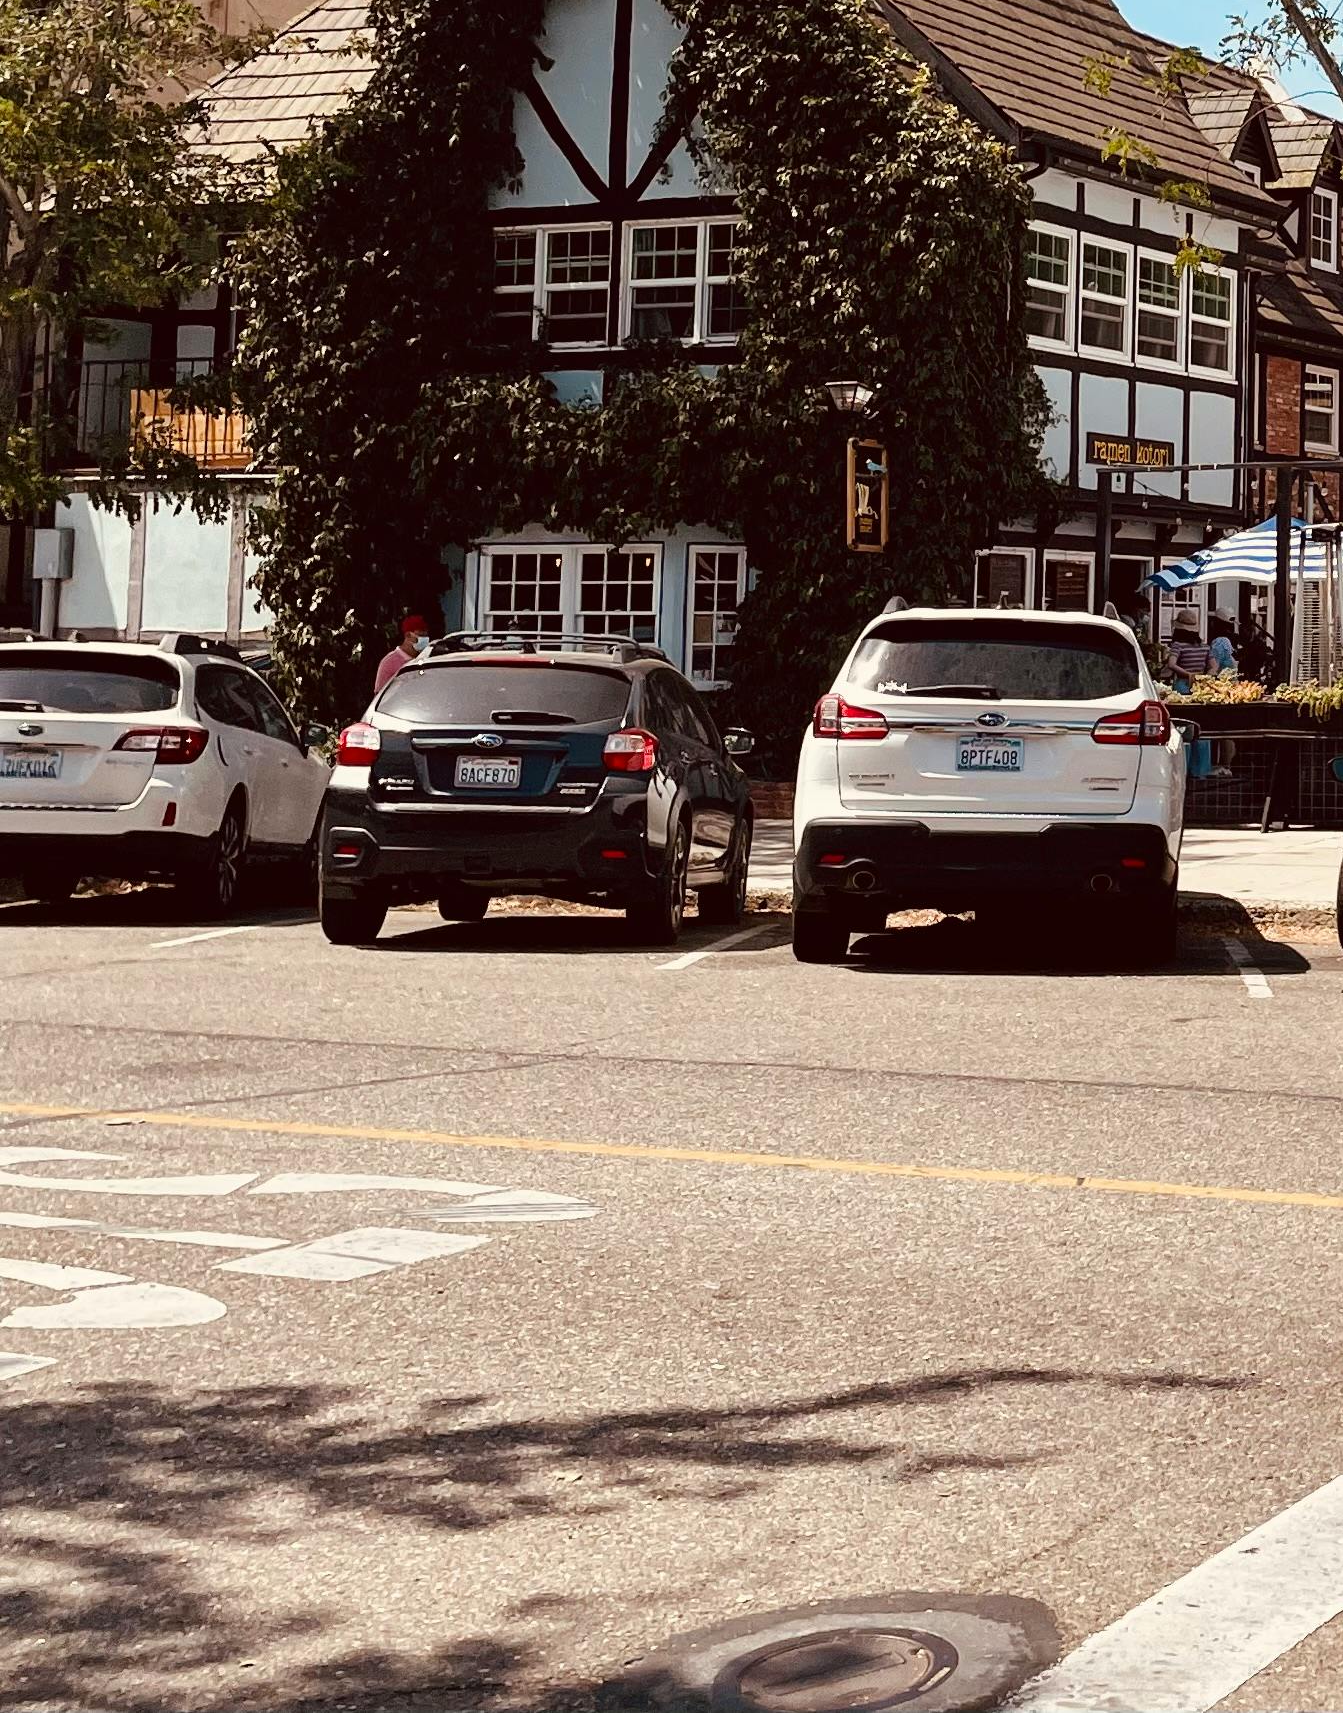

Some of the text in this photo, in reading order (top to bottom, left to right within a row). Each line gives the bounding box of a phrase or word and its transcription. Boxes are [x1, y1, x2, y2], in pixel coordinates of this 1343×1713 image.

[1093, 440, 1169, 467] ramen kotori
[960, 749, 1018, 766] 8PTF408
[460, 767, 516, 783] 8ACF870
